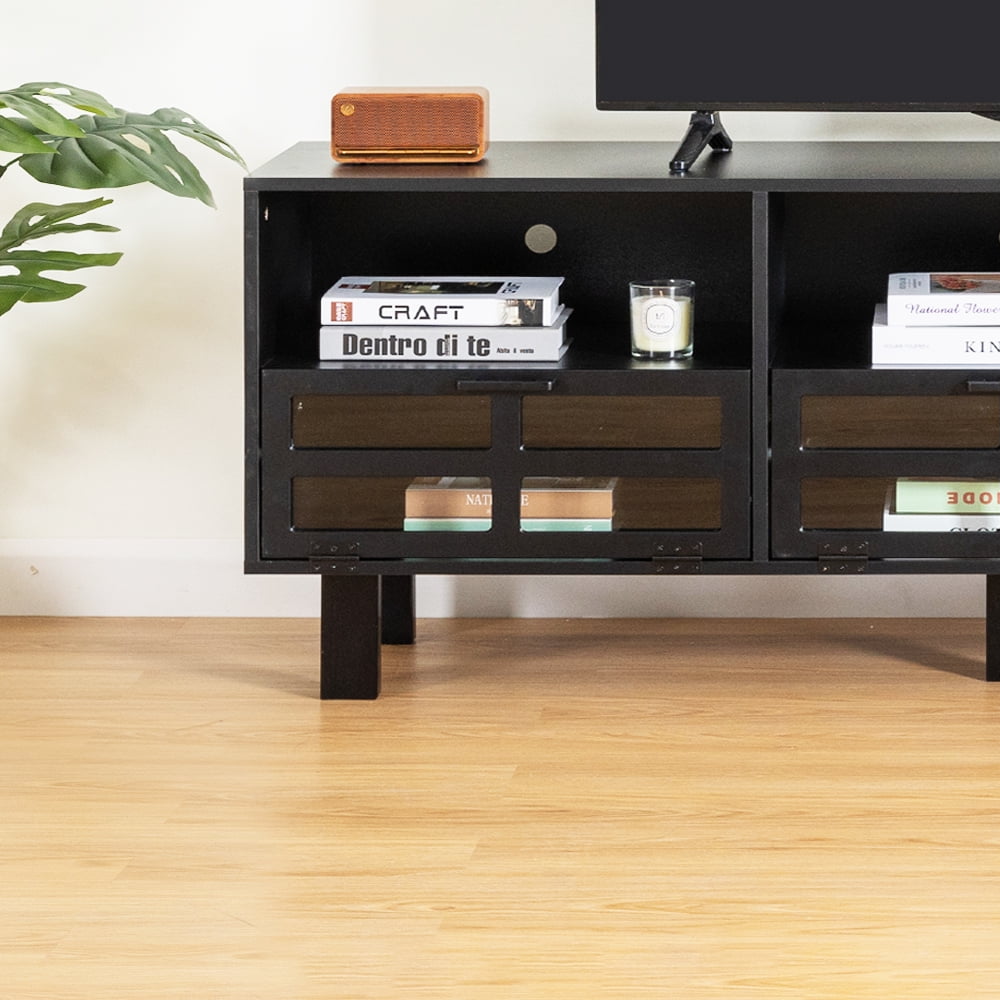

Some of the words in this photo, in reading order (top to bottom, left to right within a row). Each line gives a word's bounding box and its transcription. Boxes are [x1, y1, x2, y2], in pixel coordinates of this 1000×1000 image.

[378, 305, 465, 321] CRAFT
[904, 303, 960, 314] National
[342, 333, 427, 357] Dentro
[436, 333, 459, 357] di
[466, 335, 491, 357] te
[946, 492, 1000, 505] ODE
